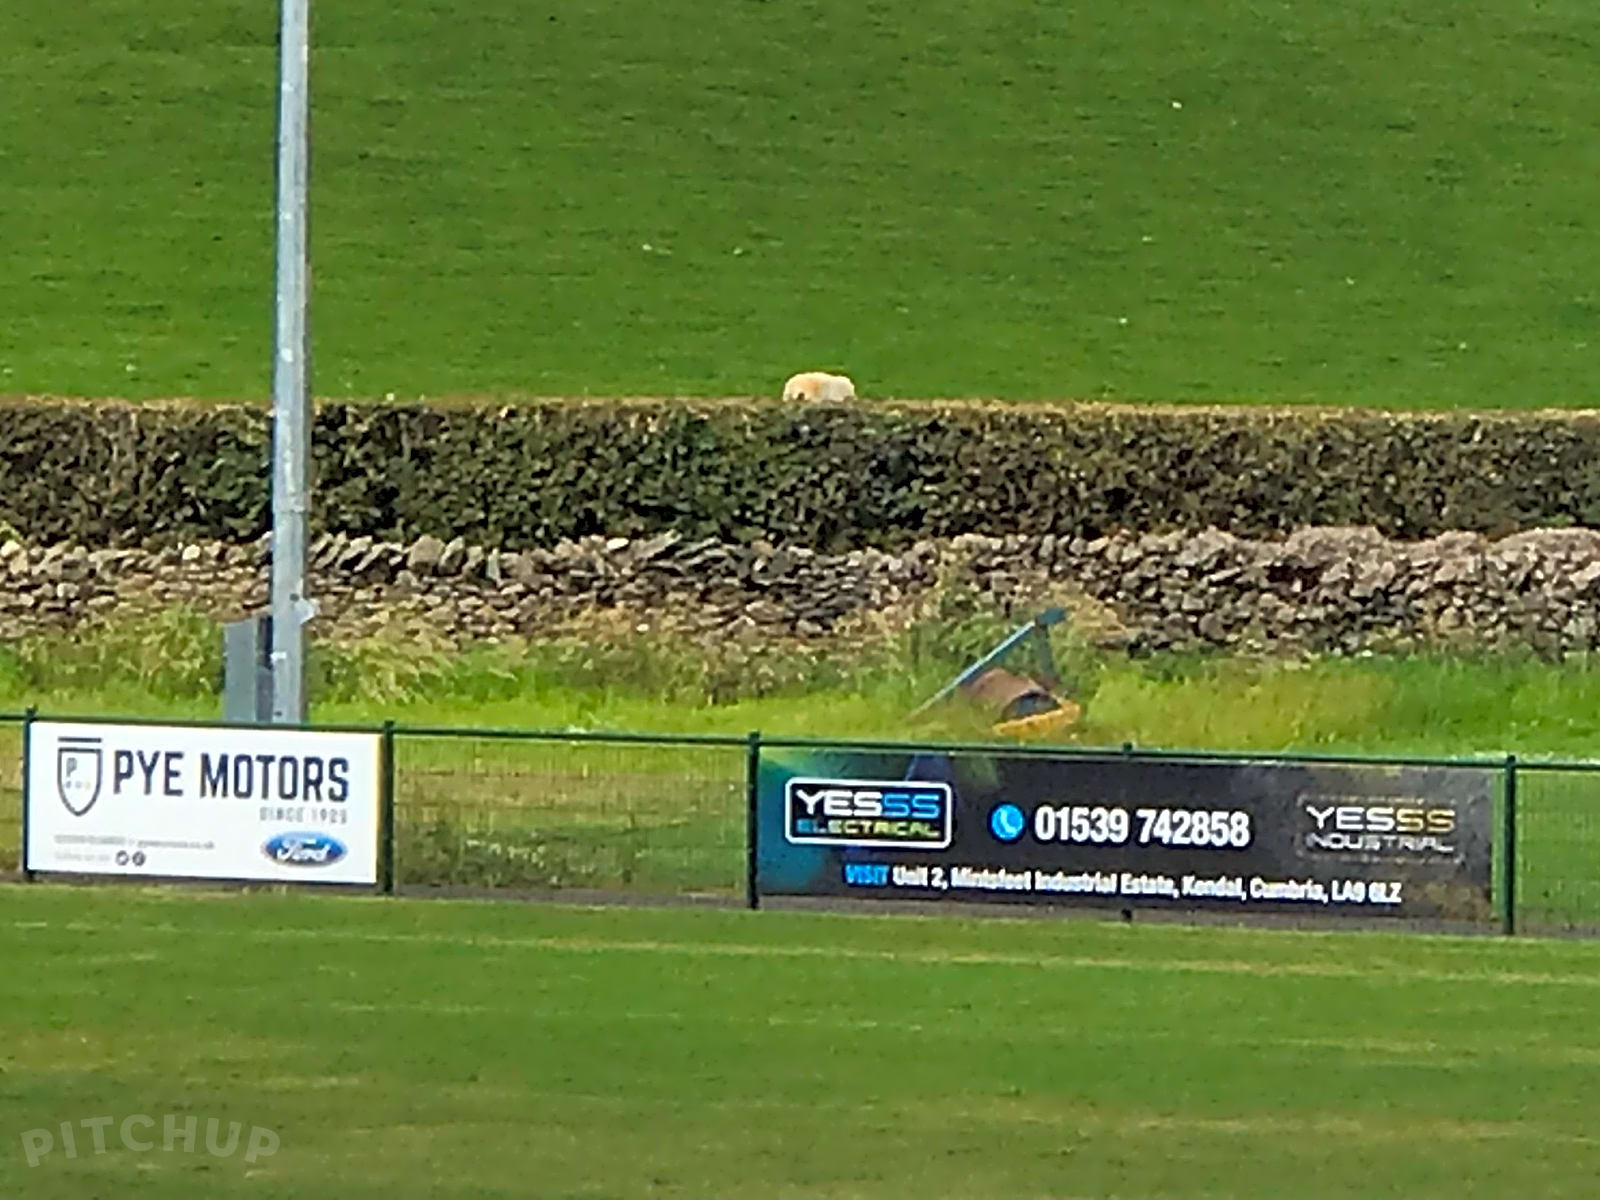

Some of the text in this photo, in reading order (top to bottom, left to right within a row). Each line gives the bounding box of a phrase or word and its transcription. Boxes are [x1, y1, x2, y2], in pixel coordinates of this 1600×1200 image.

[113, 749, 350, 802] PYE MOTORS
[796, 789, 940, 819] YESSS
[796, 819, 940, 838] ELECTRICAL
[1035, 806, 1250, 846] 01539 742858
[1306, 806, 1456, 833] YESSS
[1305, 833, 1455, 851] INDUSTRIAL
[845, 864, 889, 885] VISIT
[892, 865, 928, 887] Unit
[931, 866, 948, 891] 2,
[1035, 870, 1118, 894] Industrial
[1120, 872, 1179, 899] Estate,
[1181, 875, 1247, 901] Kendal,
[1250, 876, 1328, 904] Cumbria,
[1331, 879, 1366, 903] LA9
